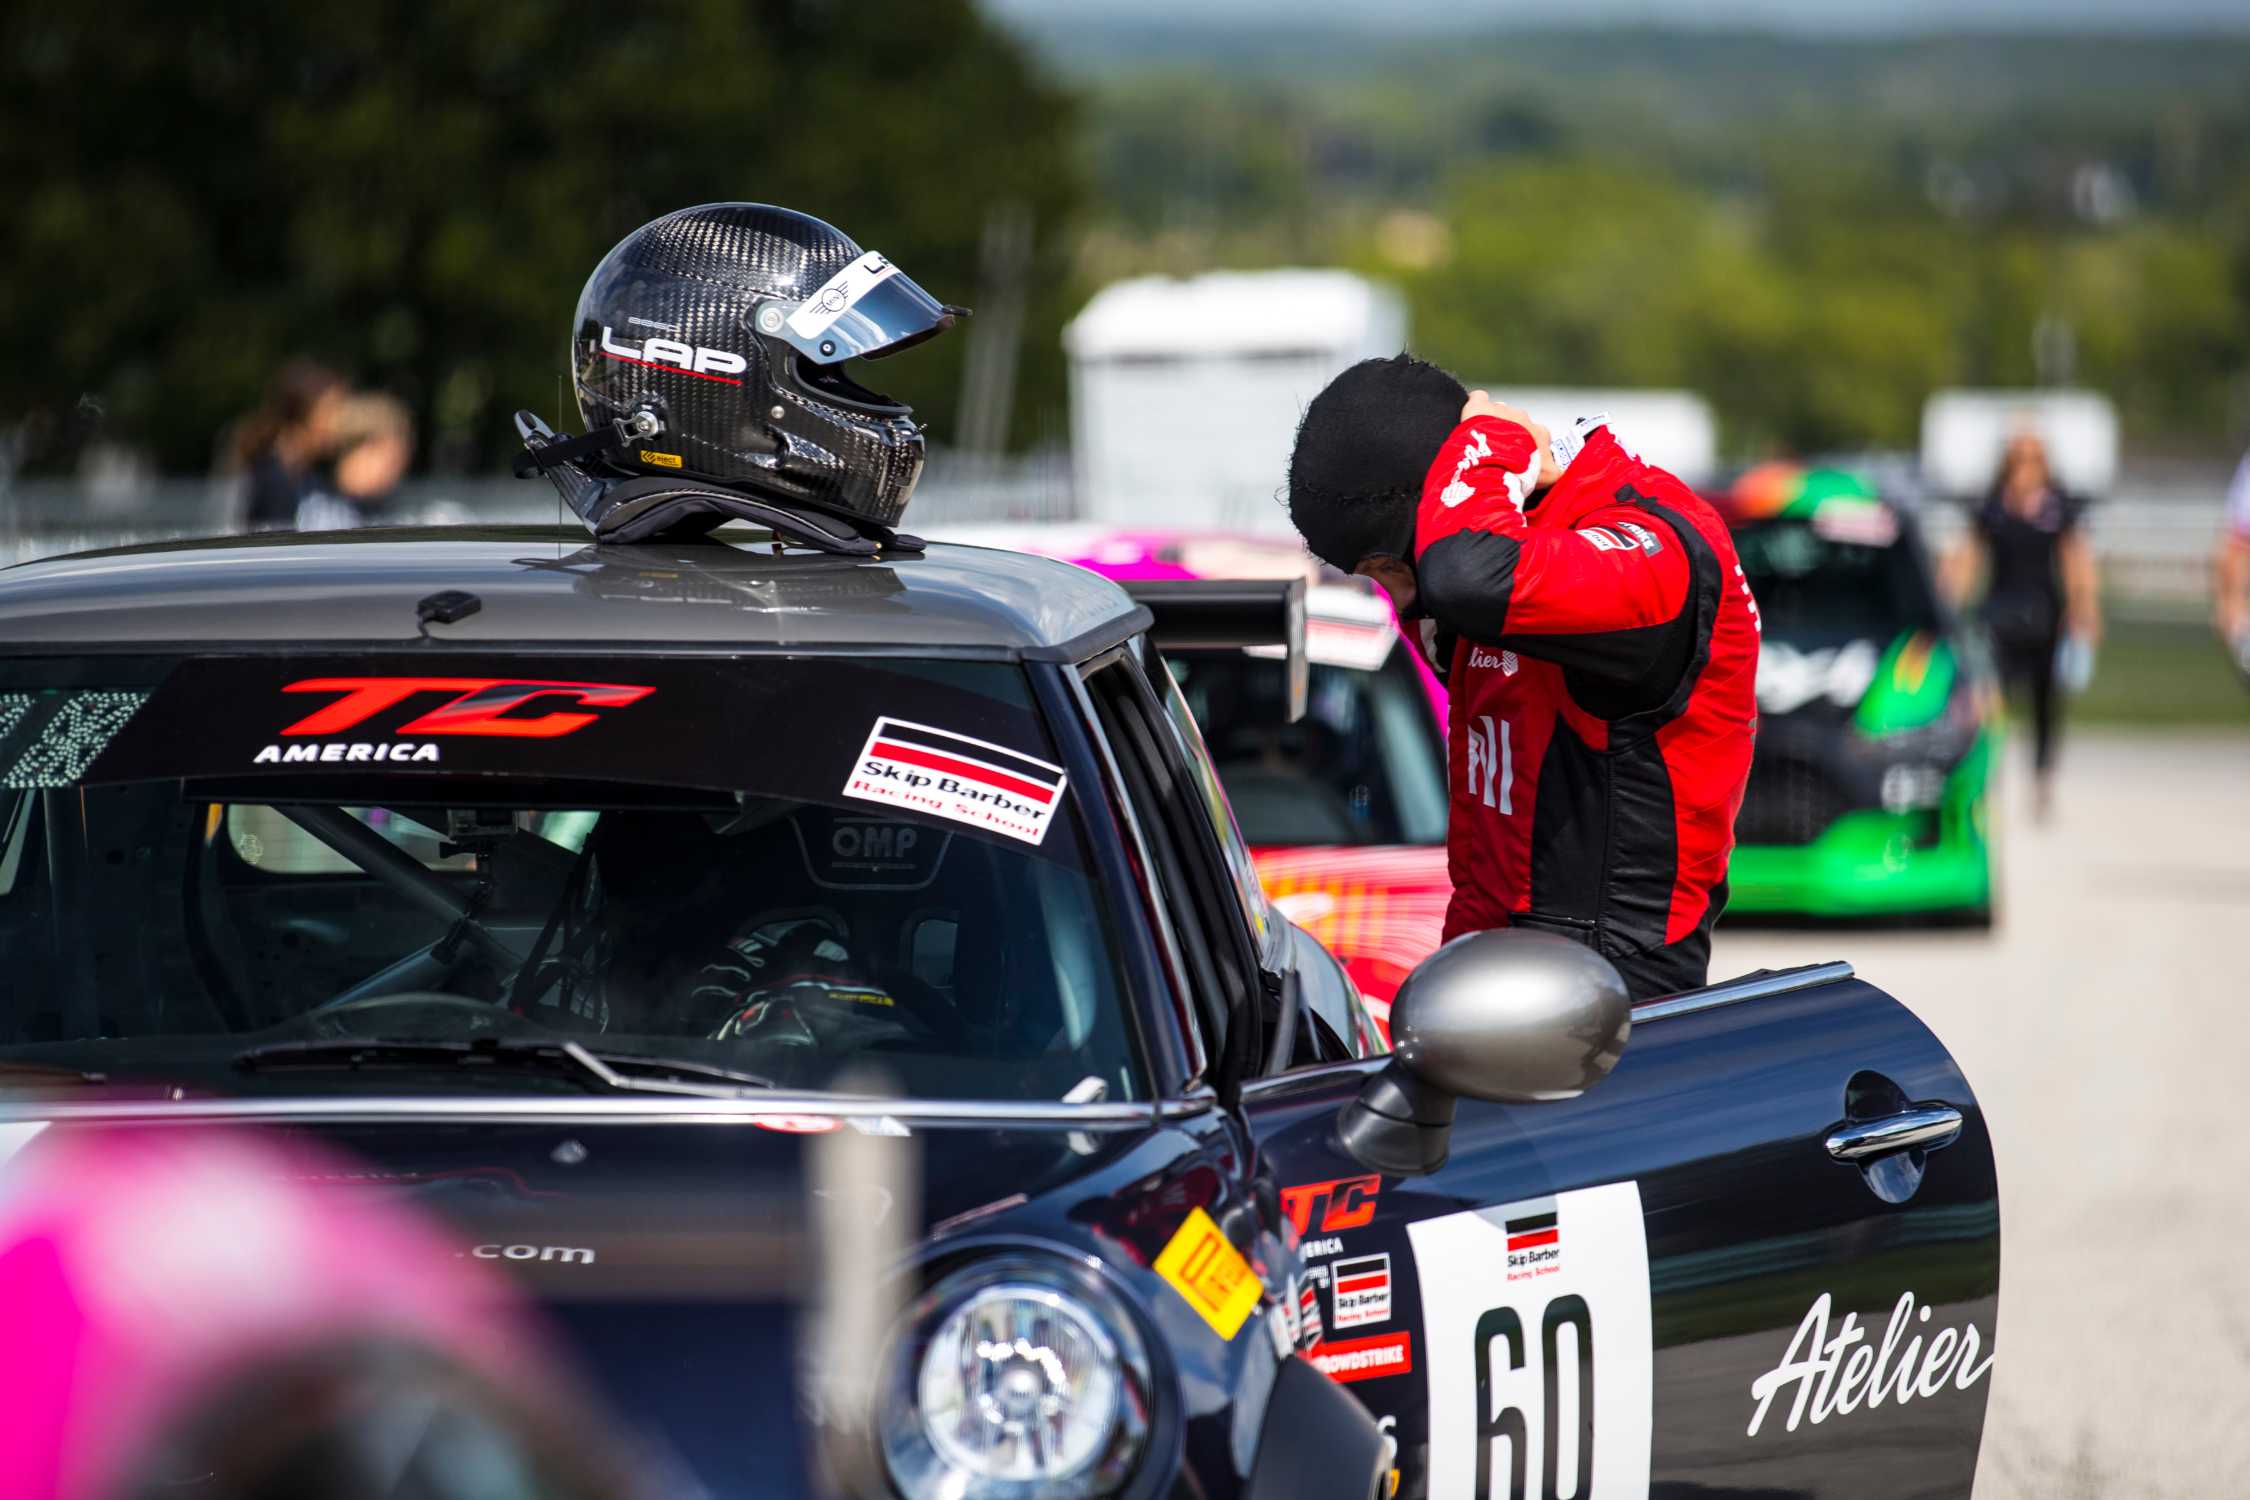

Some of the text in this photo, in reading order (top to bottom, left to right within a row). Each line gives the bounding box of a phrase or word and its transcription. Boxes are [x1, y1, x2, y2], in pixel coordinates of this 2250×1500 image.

[601, 326, 747, 374] LAP
[1468, 647, 1504, 669] lier
[280, 677, 656, 737] TC
[252, 742, 440, 763] AMERICA
[853, 780, 1039, 836] Racing School
[861, 761, 1046, 819] Skip Barber
[832, 826, 918, 858] OMP
[1280, 1172, 1381, 1237] TC
[1299, 1237, 1344, 1261] ERICA
[1528, 1248, 1560, 1264] Barber
[1746, 1291, 1995, 1437] Atelier
[1474, 1293, 1596, 1500] 60
